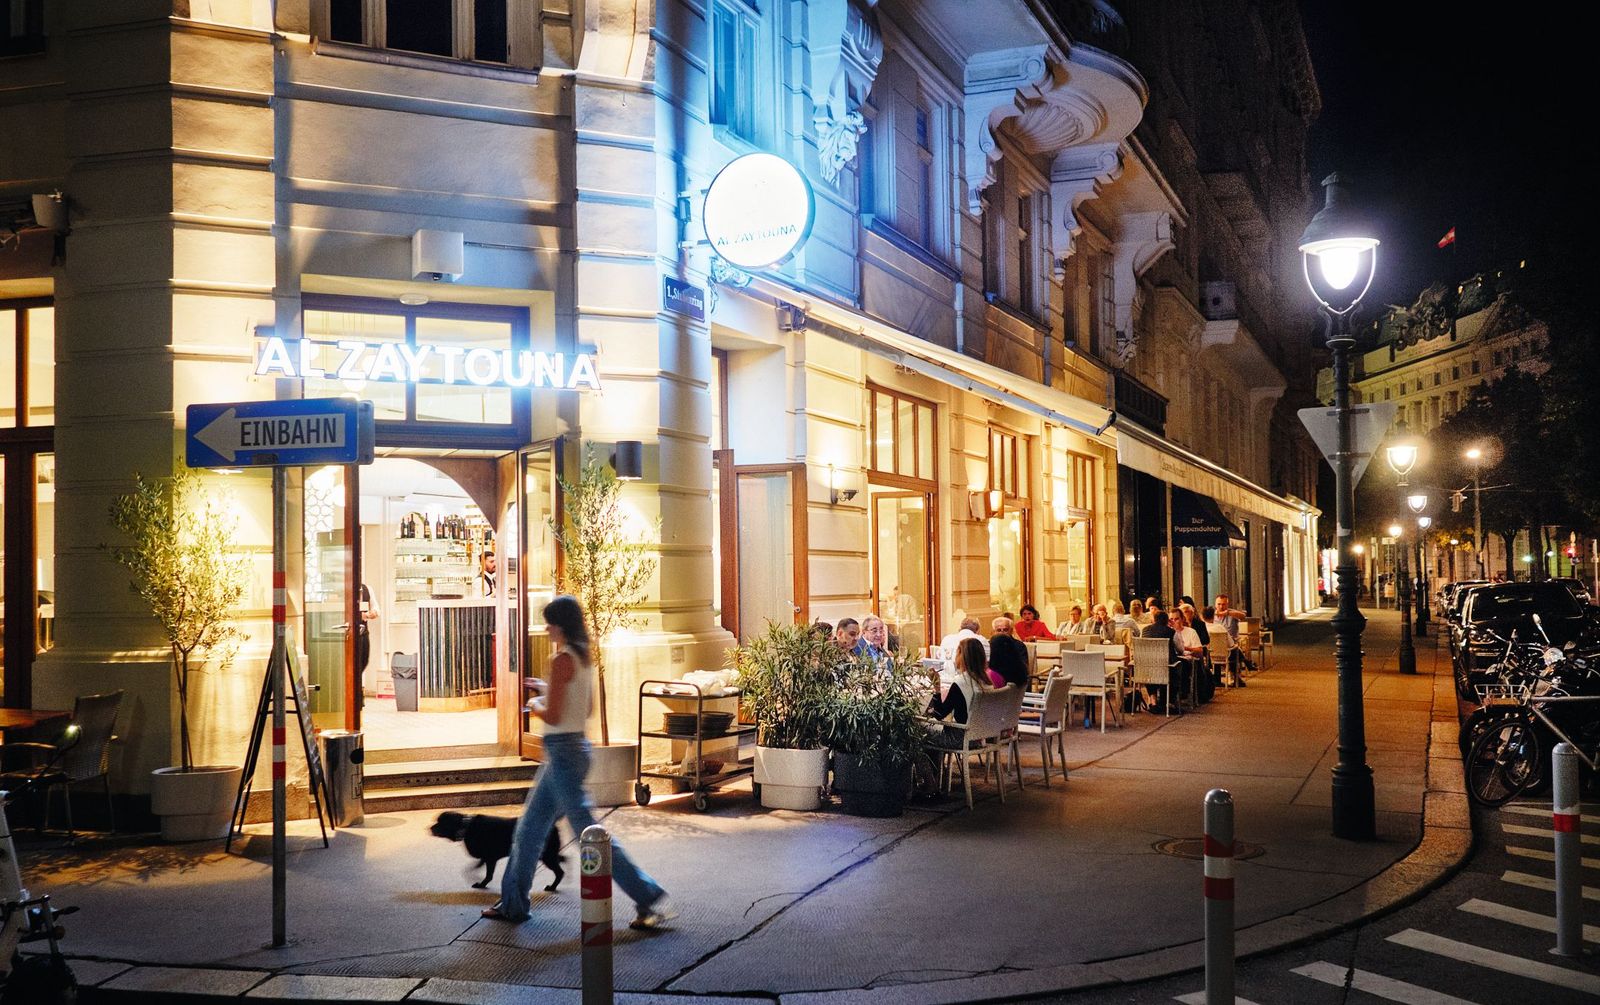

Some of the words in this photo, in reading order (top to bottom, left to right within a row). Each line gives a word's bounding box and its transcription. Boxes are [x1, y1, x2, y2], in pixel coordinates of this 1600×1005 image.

[255, 336, 325, 378] AL
[336, 340, 602, 390] ZAYTOUNA
[240, 417, 336, 446] EINBAHN
